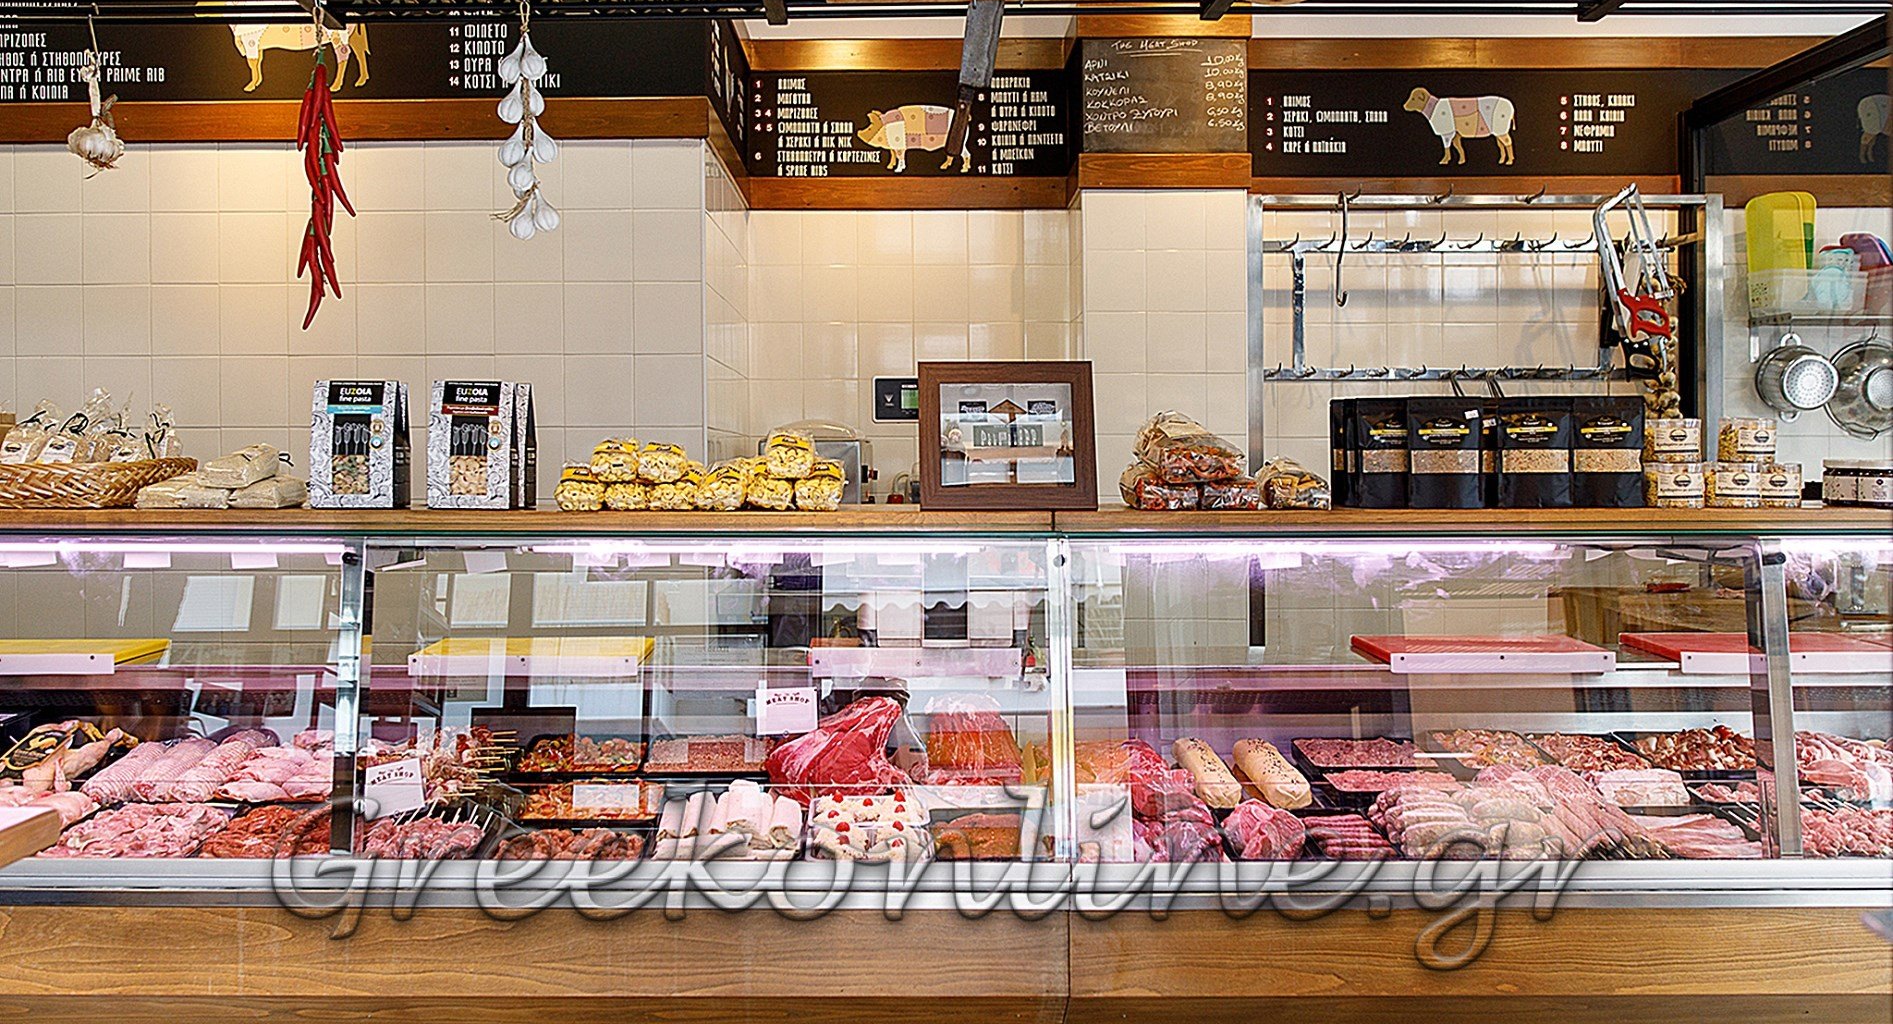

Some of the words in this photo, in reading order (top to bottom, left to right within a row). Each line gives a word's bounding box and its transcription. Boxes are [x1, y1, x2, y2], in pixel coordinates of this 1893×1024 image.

[449, 27, 460, 37] 11
[449, 43, 460, 54] 12
[449, 59, 460, 70] 13
[464, 57, 492, 73] ΟΥΡΑ
[70, 68, 88, 83] EY
[106, 67, 141, 83] PRIME
[146, 67, 165, 83] RIB
[449, 76, 460, 87] 14
[464, 73, 496, 89] ΚΟΤΣΙ
[754, 79, 761, 89] 1
[754, 94, 762, 103] 2
[978, 93, 985, 102] 8
[1266, 97, 1272, 106] 1
[1560, 96, 1568, 105] 5
[754, 109, 761, 118] 3
[764, 109, 772, 118] 4
[1266, 112, 1274, 121] 2
[1560, 111, 1567, 121] 6
[754, 123, 762, 132] 4
[765, 123, 773, 132] 5
[978, 122, 985, 132] 9
[1266, 127, 1274, 136] 3
[1560, 126, 1567, 135] 7
[977, 137, 987, 147] 10
[1265, 142, 1273, 151] 4
[1560, 140, 1568, 150] 8
[754, 152, 762, 160] 6
[978, 165, 986, 174] 11
